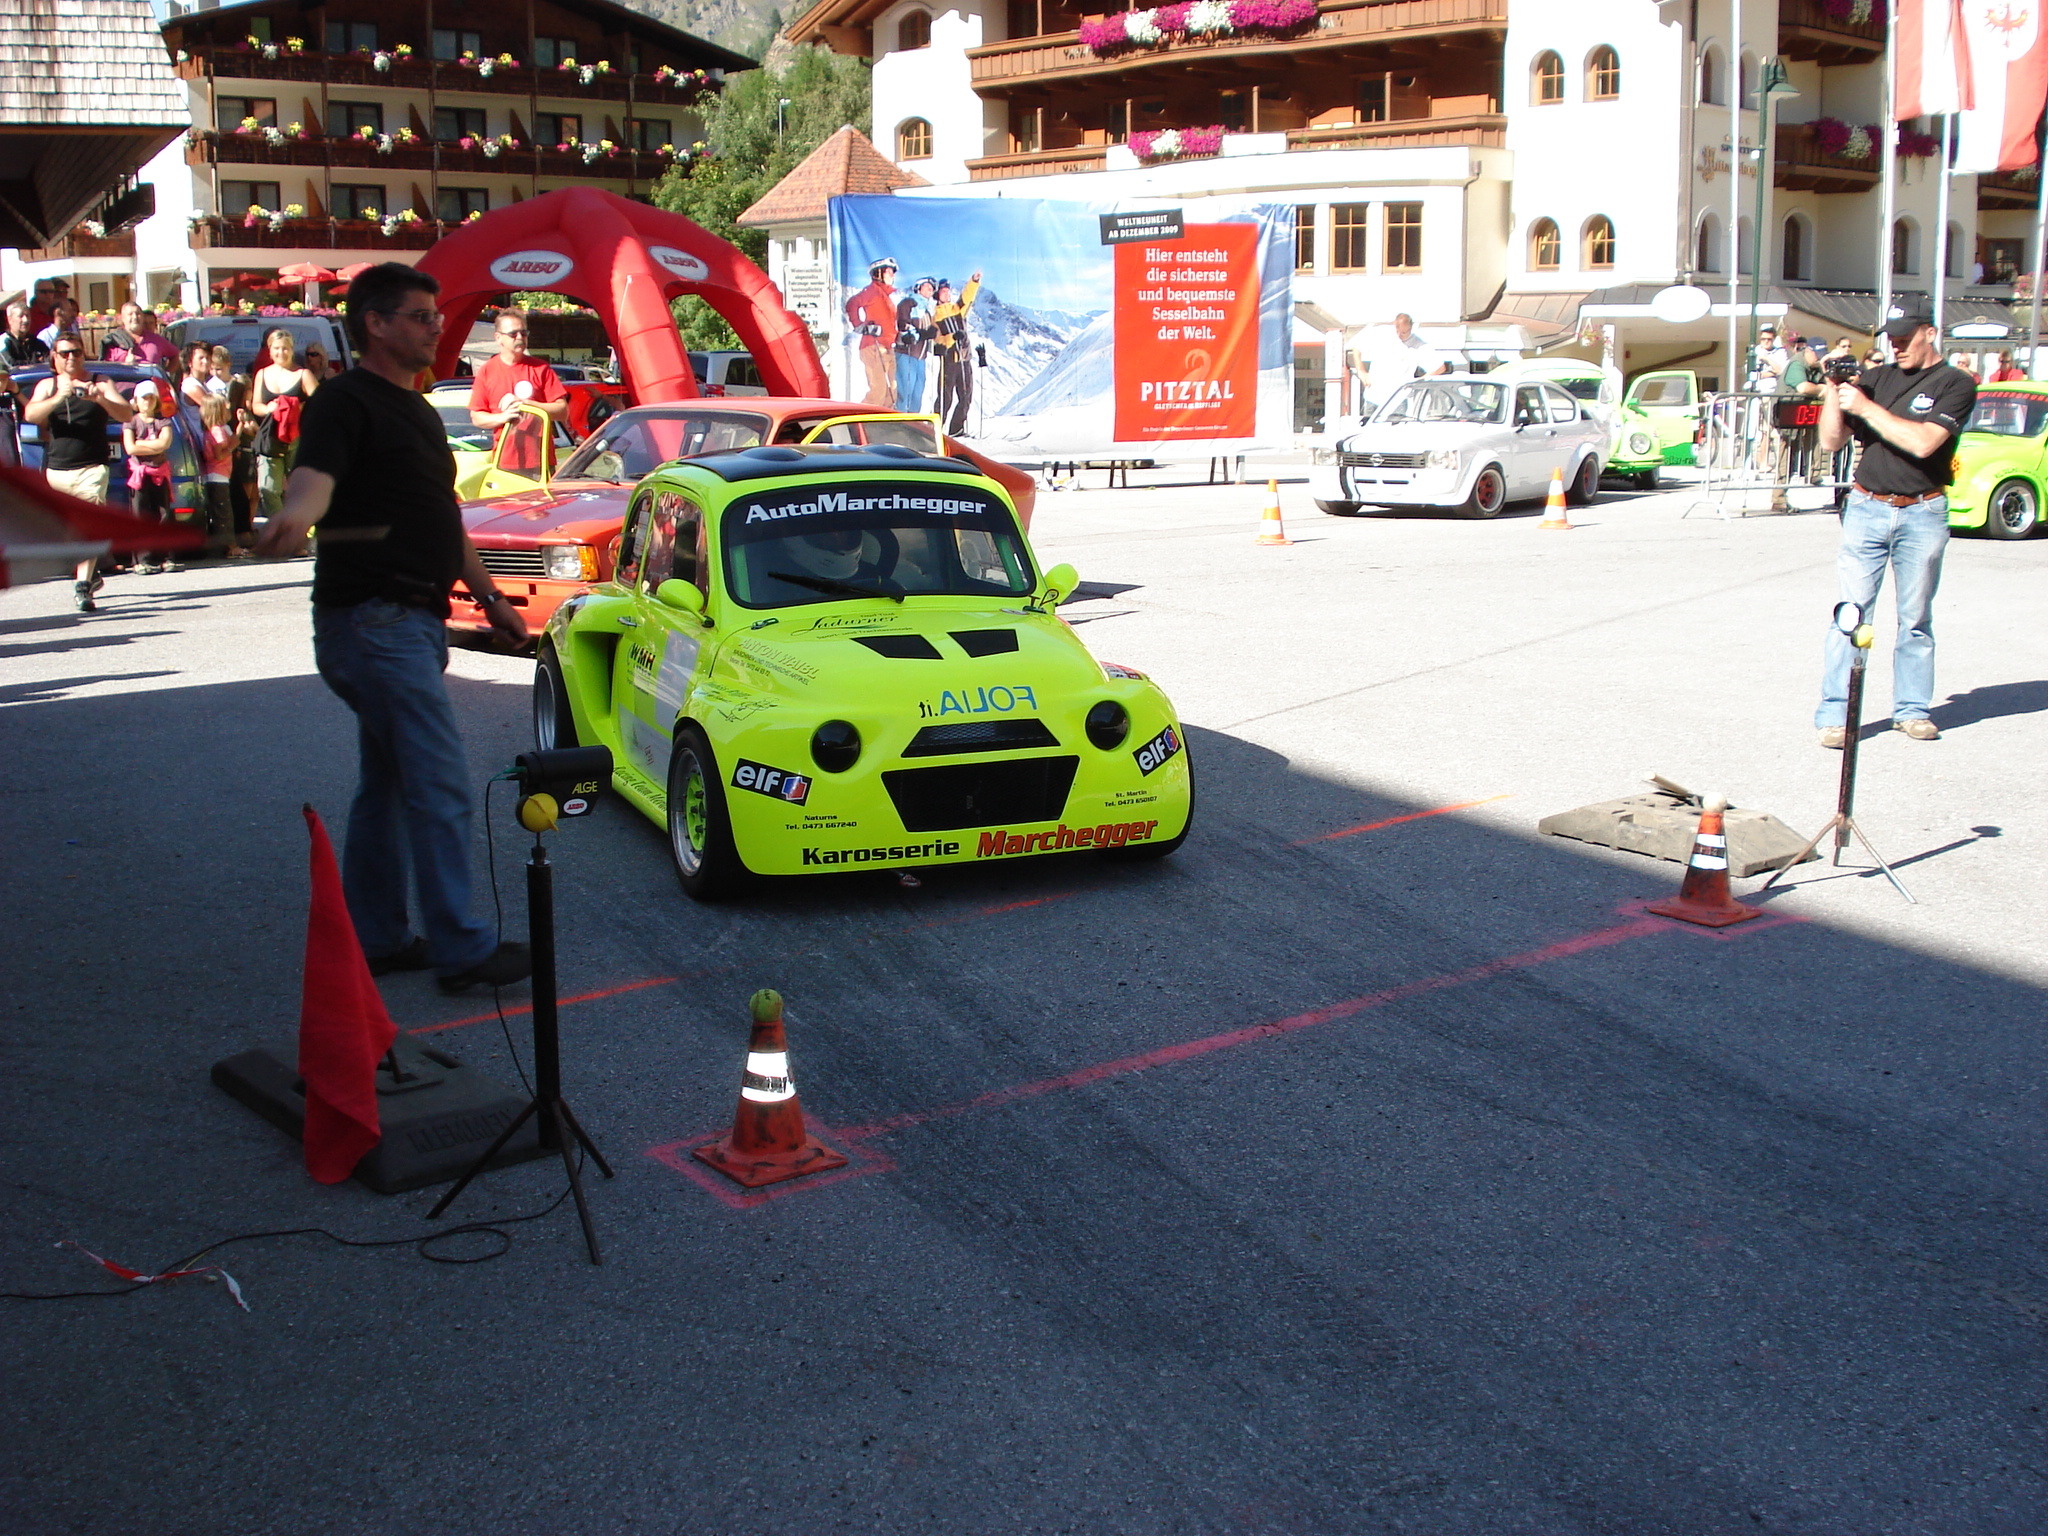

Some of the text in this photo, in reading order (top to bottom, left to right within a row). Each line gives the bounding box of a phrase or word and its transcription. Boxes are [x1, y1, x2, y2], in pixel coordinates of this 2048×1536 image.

[1117, 214, 1168, 227] WELTNEUHEIT
[1108, 225, 1179, 239] AB DEZEMBER 2009
[1145, 248, 1228, 262] Hier entsteht
[1146, 267, 1228, 282] die sicherste
[1138, 287, 1236, 304] und bequemste
[1152, 306, 1225, 321] Sesselbahn
[1157, 326, 1216, 340] der Welt.
[1140, 380, 1235, 402] PITZTAL
[745, 492, 987, 524] AutoMarchegger
[738, 638, 783, 660] ANTON
[1138, 737, 1166, 771] elf
[736, 765, 782, 793] elf
[571, 781, 598, 795] ALGE
[975, 819, 1159, 858] Marchegger
[802, 839, 960, 867] Karosserie
